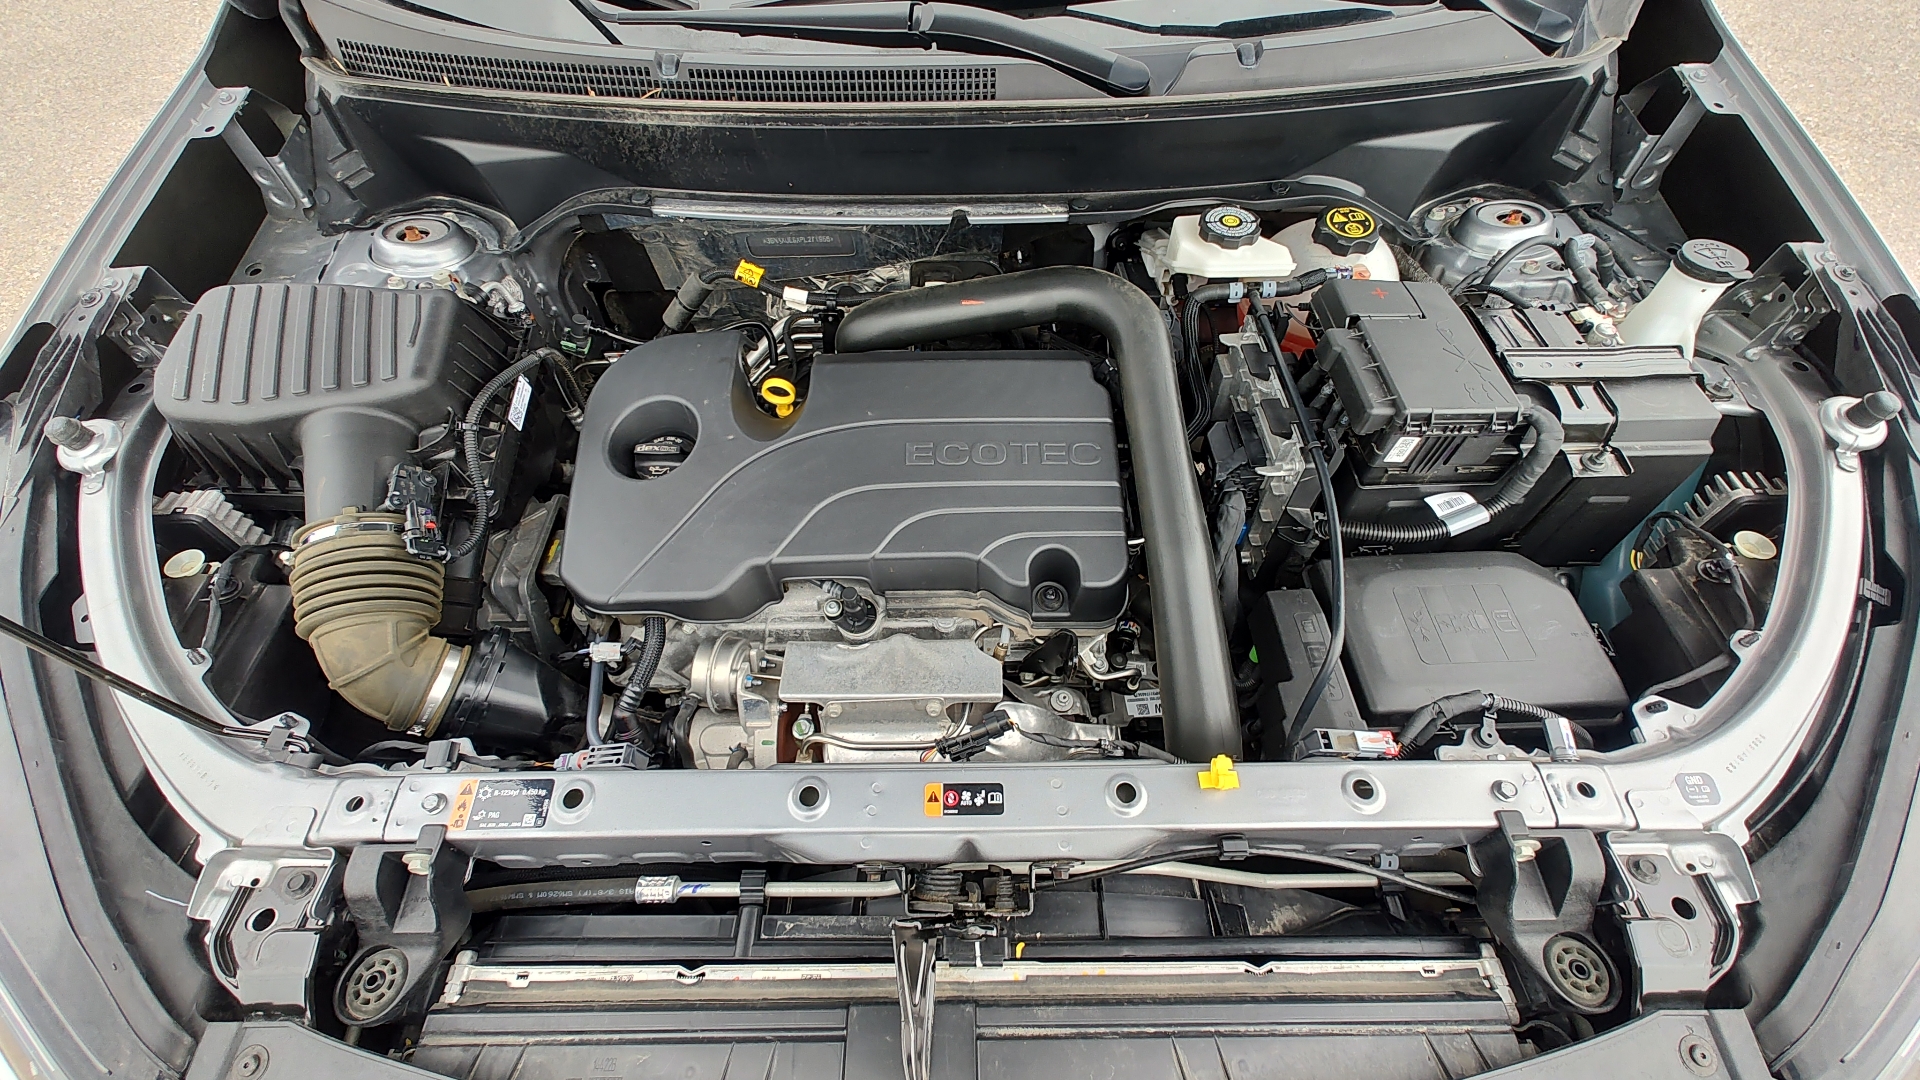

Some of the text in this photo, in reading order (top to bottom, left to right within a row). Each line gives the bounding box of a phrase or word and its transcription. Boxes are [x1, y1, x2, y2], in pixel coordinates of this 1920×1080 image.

[905, 441, 1101, 466] ECOTEC
[1684, 775, 1704, 785] GND
[494, 787, 547, 797] R-1234yf 0.450 kg
[487, 811, 500, 819] PAG
